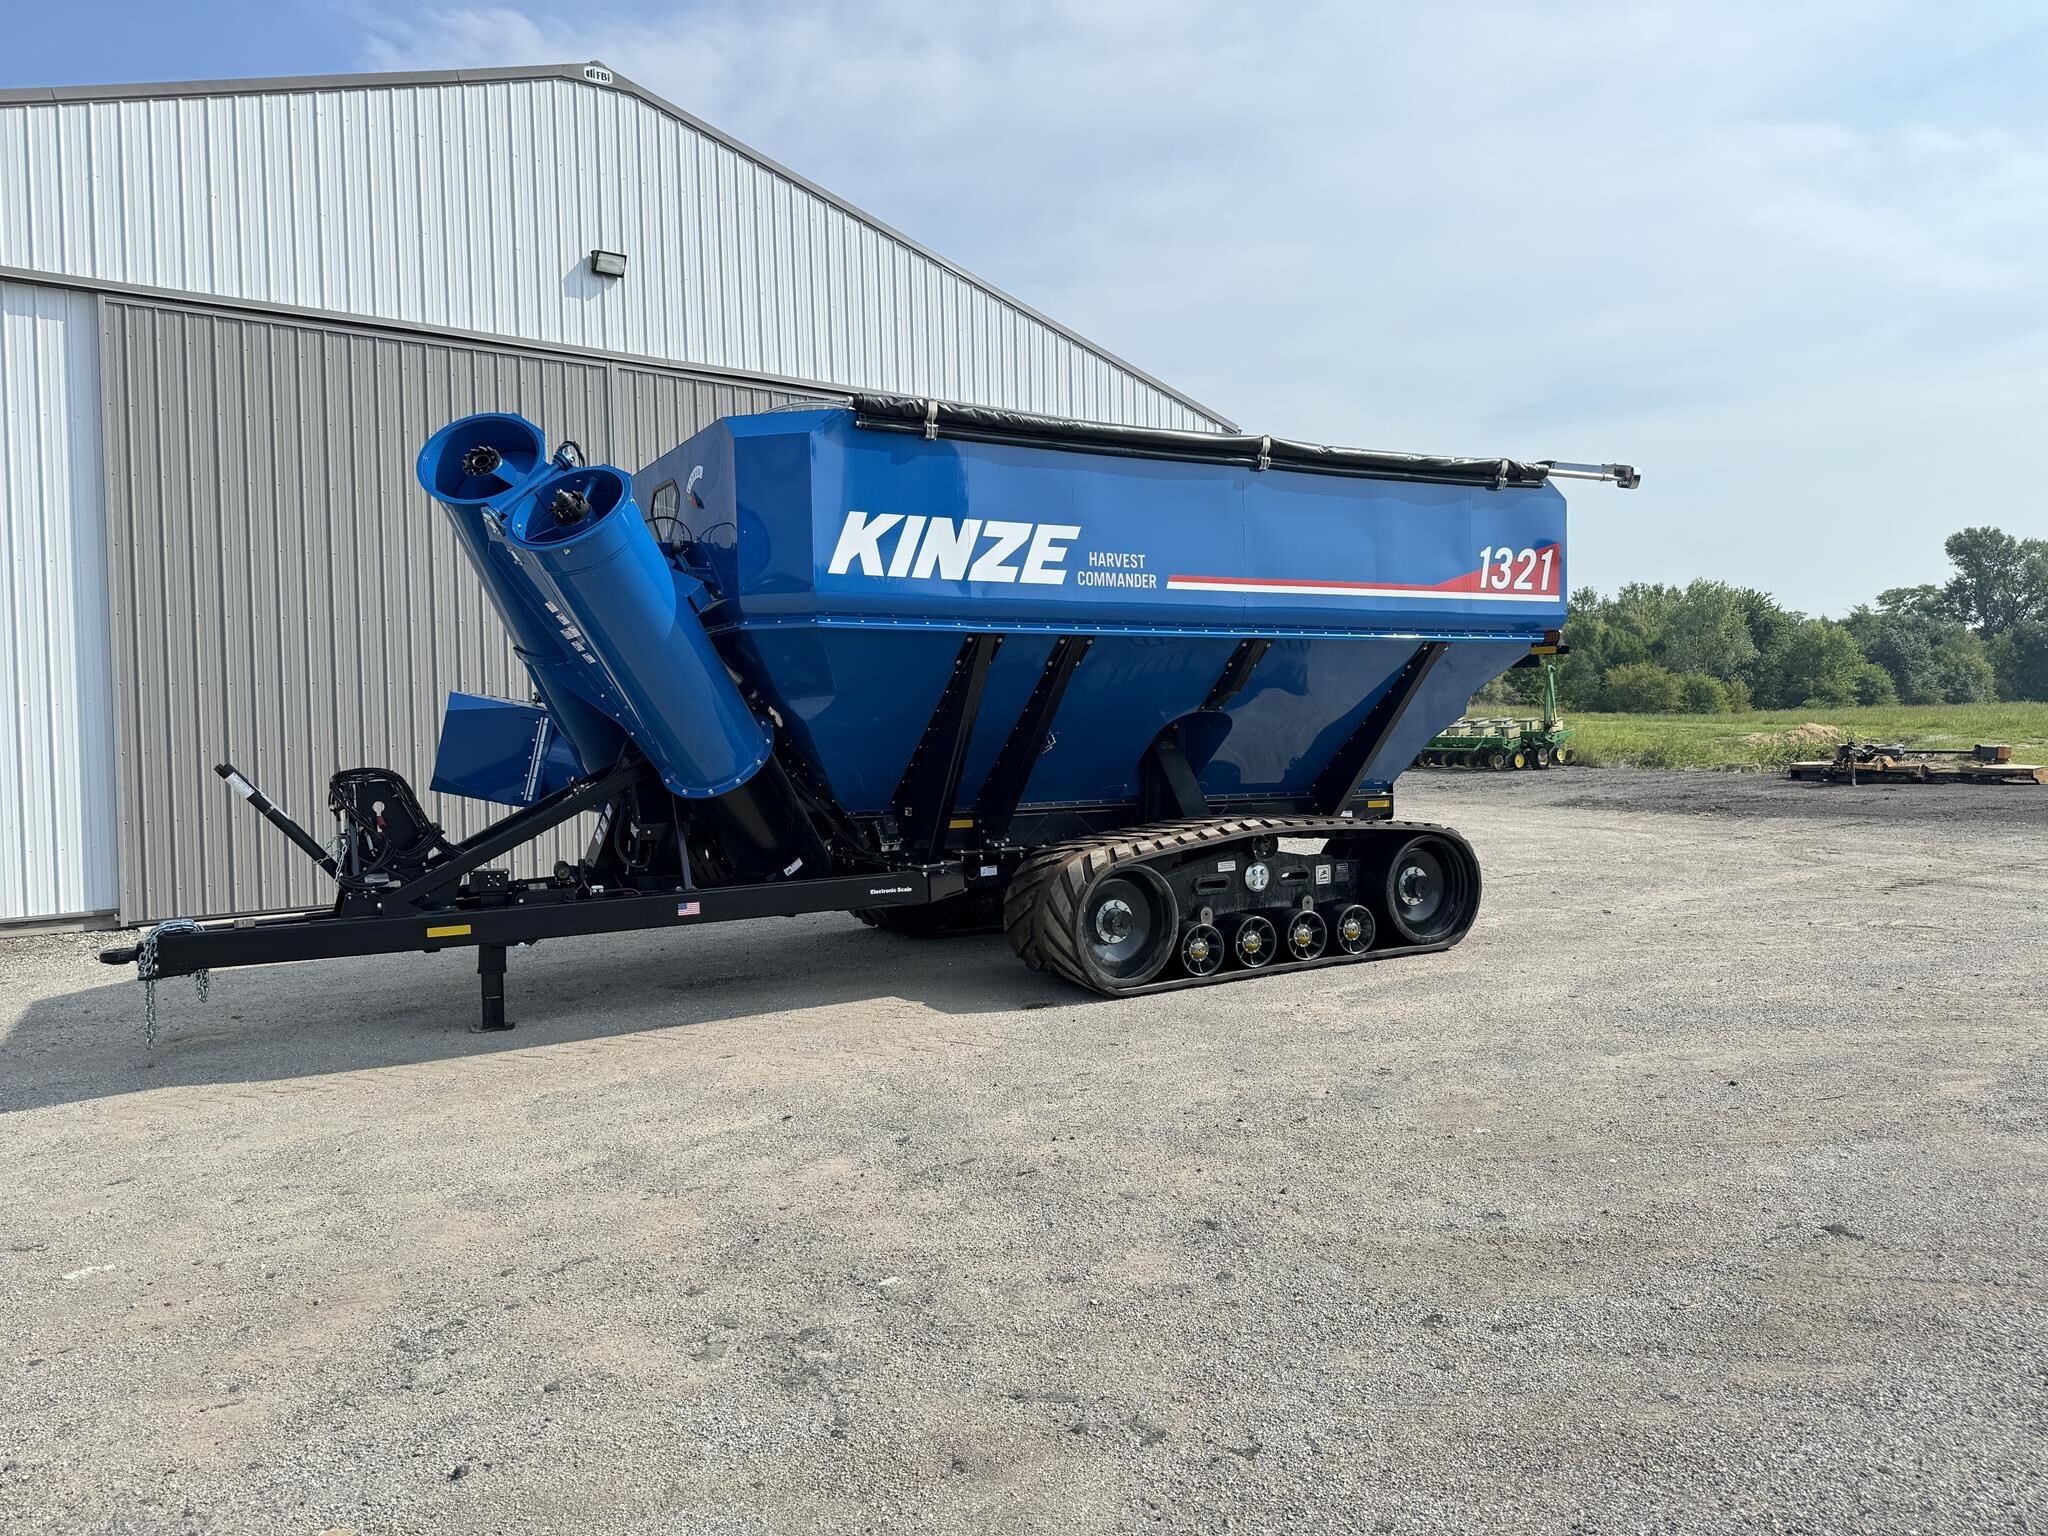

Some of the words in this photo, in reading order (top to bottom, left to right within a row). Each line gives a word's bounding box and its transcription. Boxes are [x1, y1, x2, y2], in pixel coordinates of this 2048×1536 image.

[596, 71, 610, 82] FBI
[828, 511, 1081, 585] KINZE
[1088, 551, 1146, 569] HARVEST
[1480, 546, 1553, 591] 1321
[1077, 571, 1157, 589] COMMANDER
